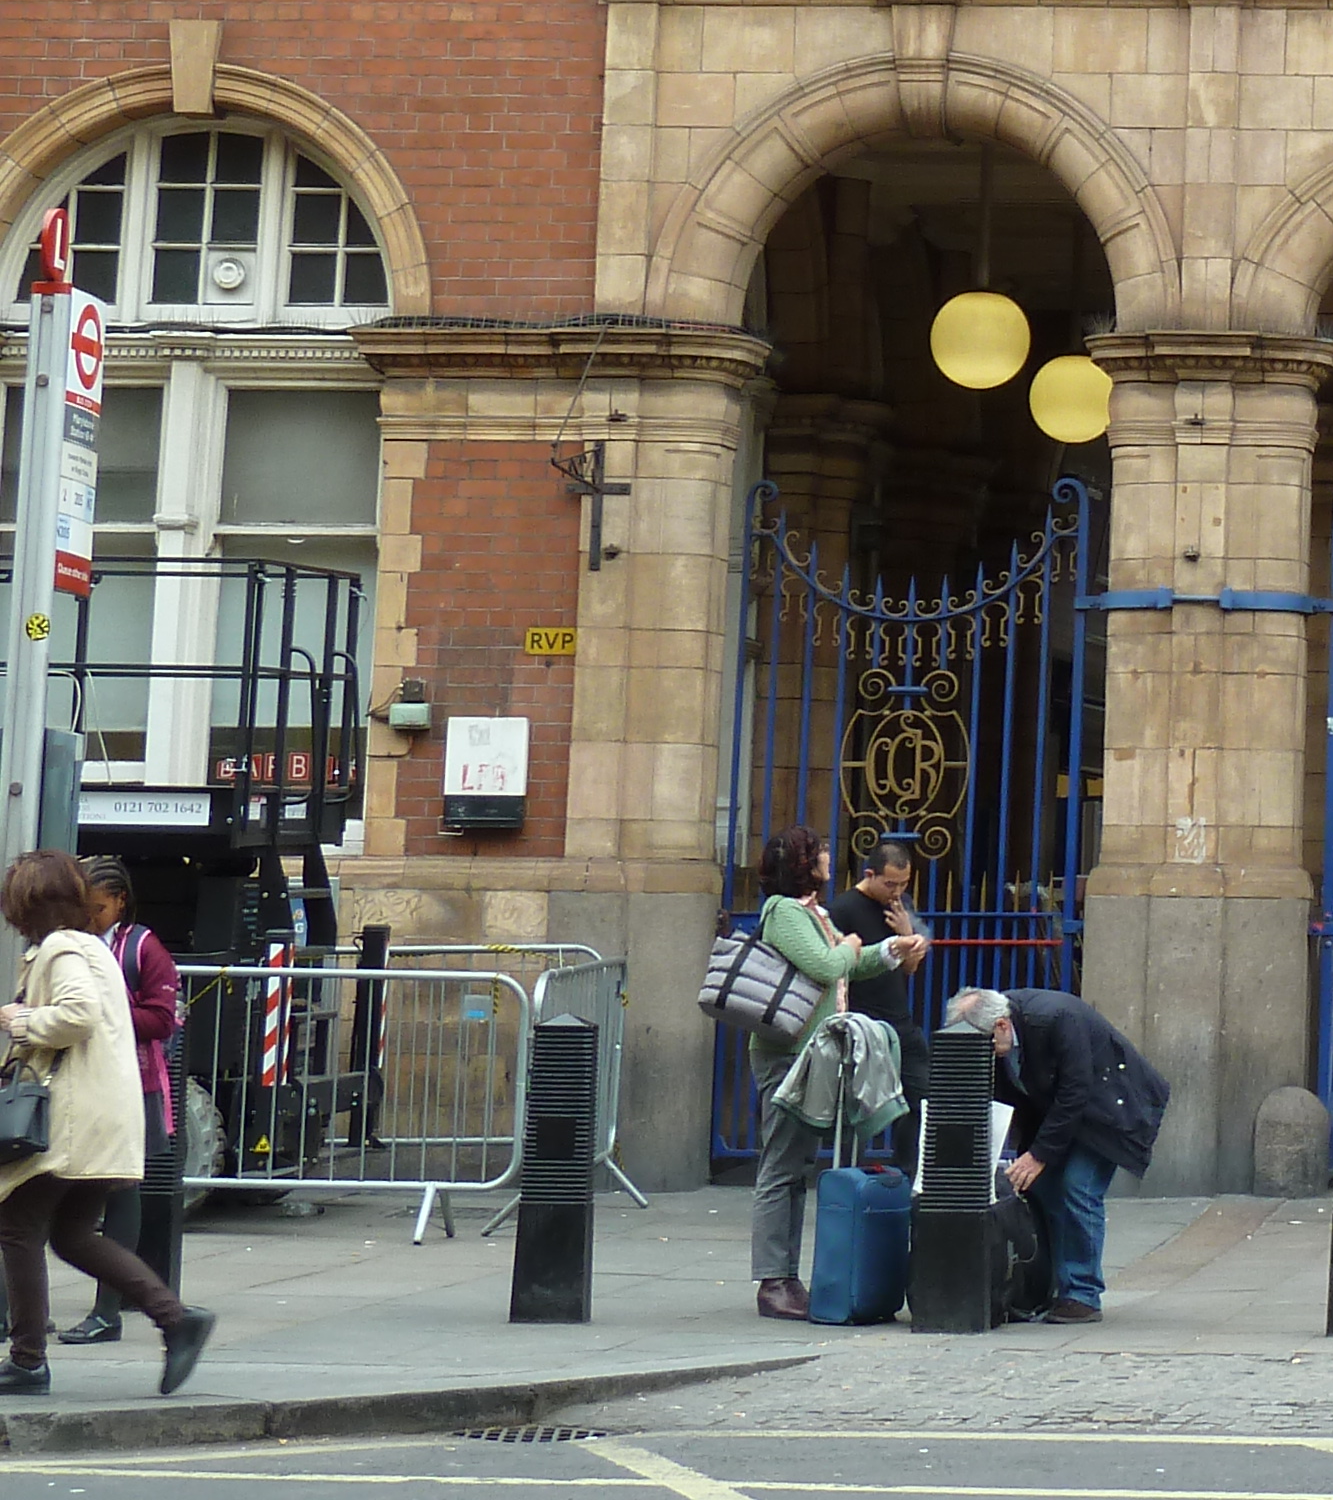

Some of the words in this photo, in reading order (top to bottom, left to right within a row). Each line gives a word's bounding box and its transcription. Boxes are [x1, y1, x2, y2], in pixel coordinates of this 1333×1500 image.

[53, 218, 65, 271] L
[530, 632, 574, 650] RVP
[114, 802, 142, 813] 0121
[147, 802, 169, 813] 702
[173, 803, 202, 814] 1642
